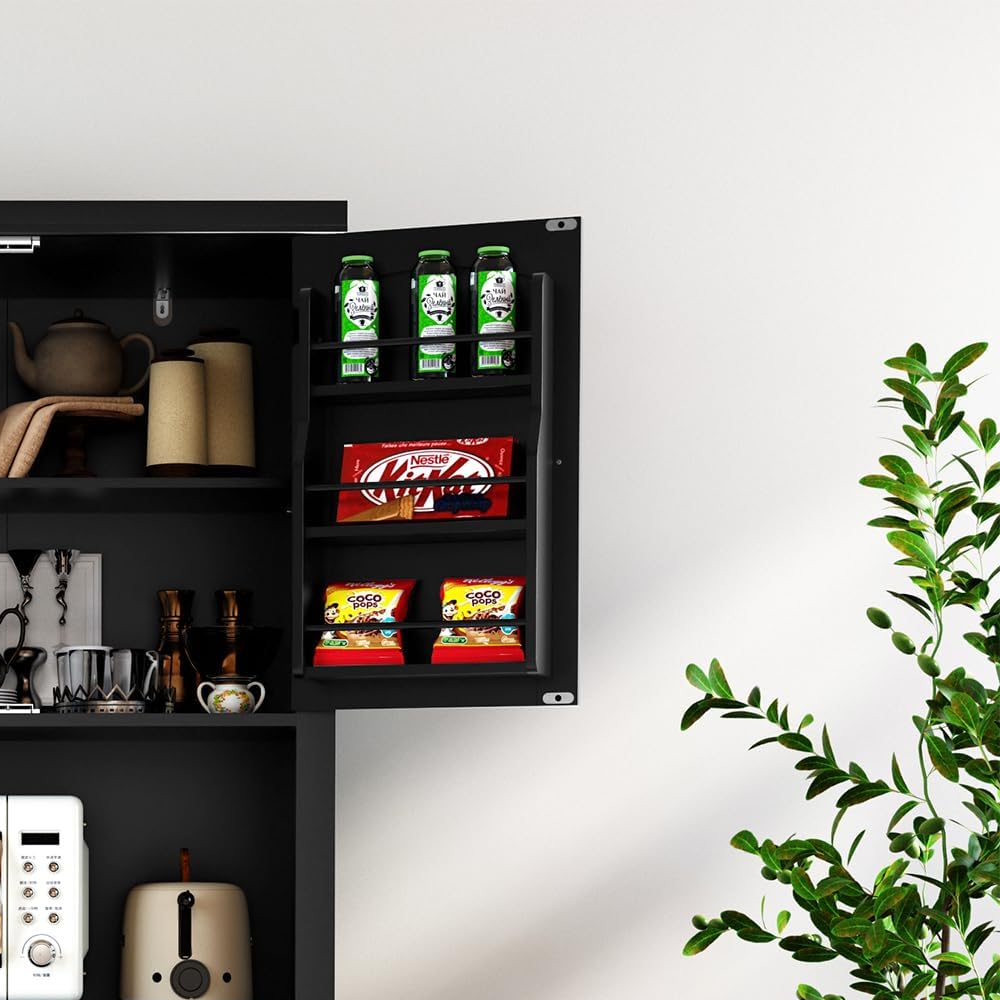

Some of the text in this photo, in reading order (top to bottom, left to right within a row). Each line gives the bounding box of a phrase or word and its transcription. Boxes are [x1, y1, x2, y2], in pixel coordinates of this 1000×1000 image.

[410, 454, 449, 465] Nestlé
[353, 601, 378, 610] pops
[472, 598, 498, 607] pops
